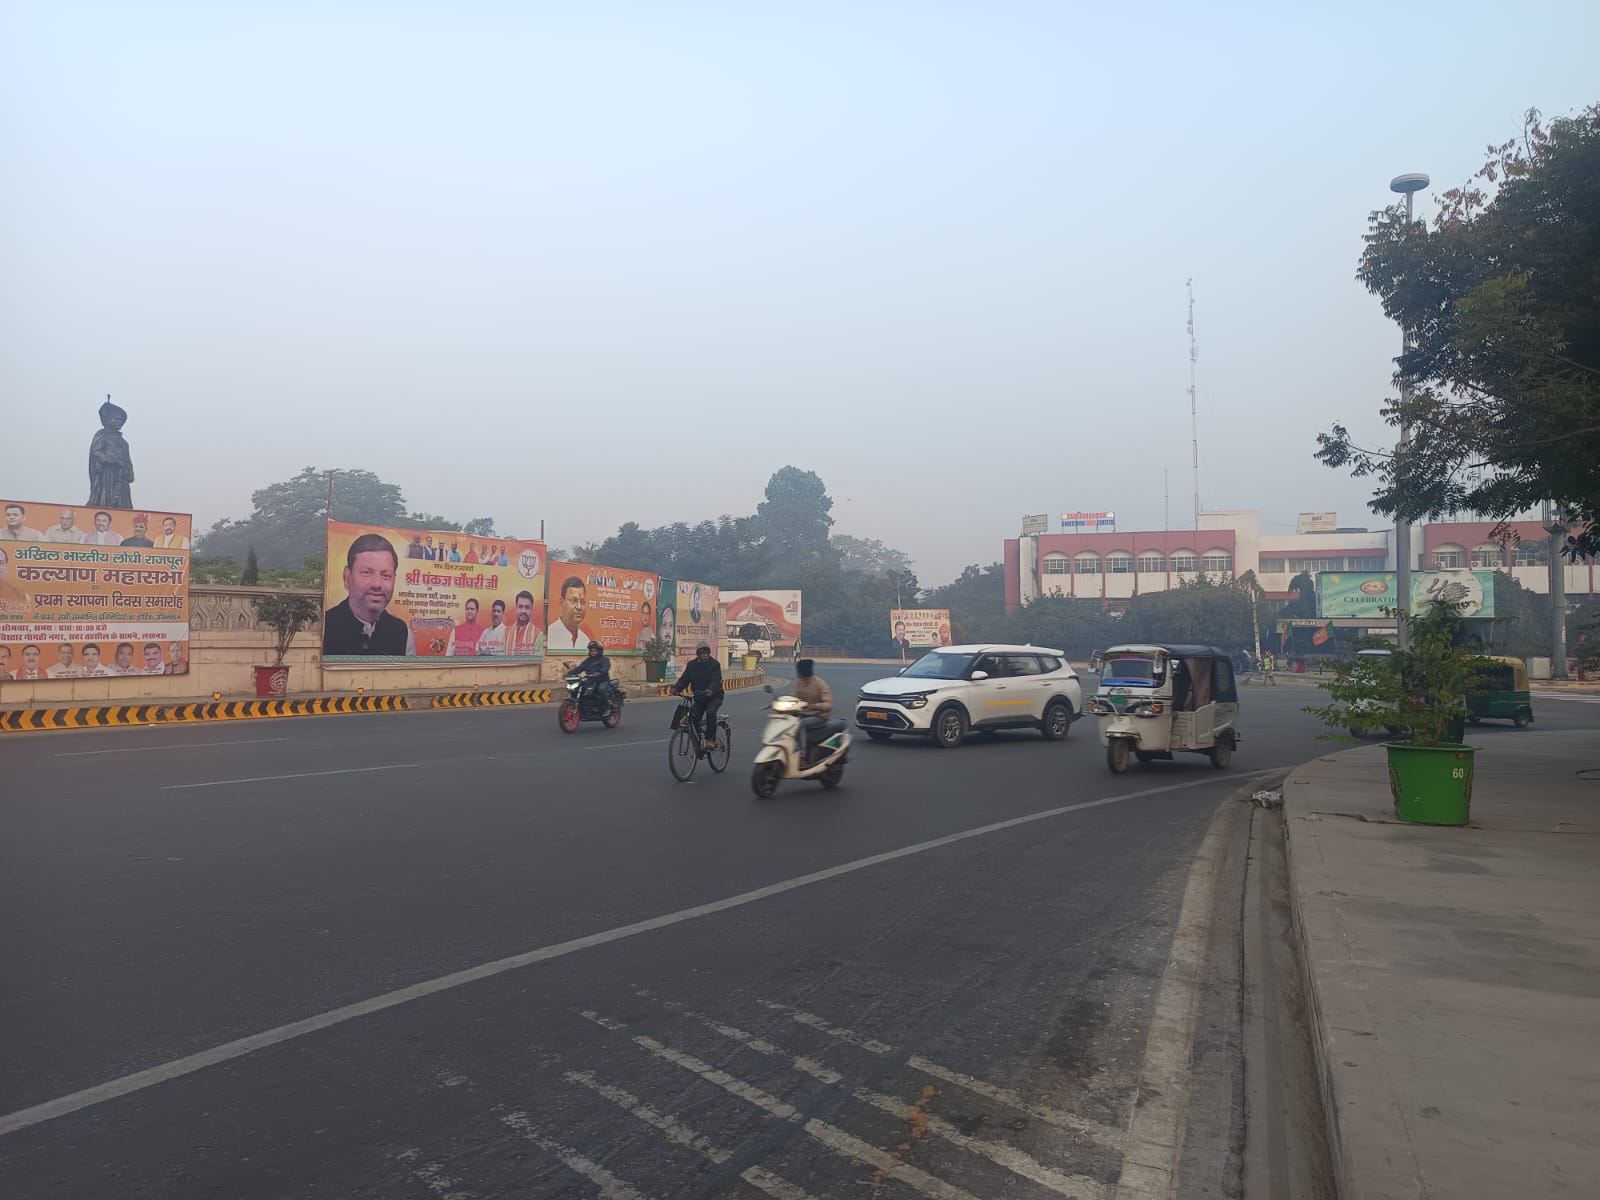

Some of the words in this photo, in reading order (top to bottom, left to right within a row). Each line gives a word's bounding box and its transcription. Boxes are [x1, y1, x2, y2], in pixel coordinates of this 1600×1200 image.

[14, 546, 60, 561] अखिल
[63, 549, 109, 562] भारतीय
[112, 551, 141, 564] लोधी
[145, 555, 184, 569] राजपूत
[16, 566, 97, 582] कल्याण
[103, 569, 184, 585] महासभा
[406, 569, 420, 586] श्री
[422, 572, 452, 586] पंकज
[454, 573, 484, 588] चौधरी
[485, 574, 498, 590] जी
[34, 594, 63, 608] प्रथम
[67, 595, 108, 607] स्थापना
[112, 591, 141, 607] दिवस
[145, 592, 184, 608] समारोह
[1453, 768, 1464, 779] 60
